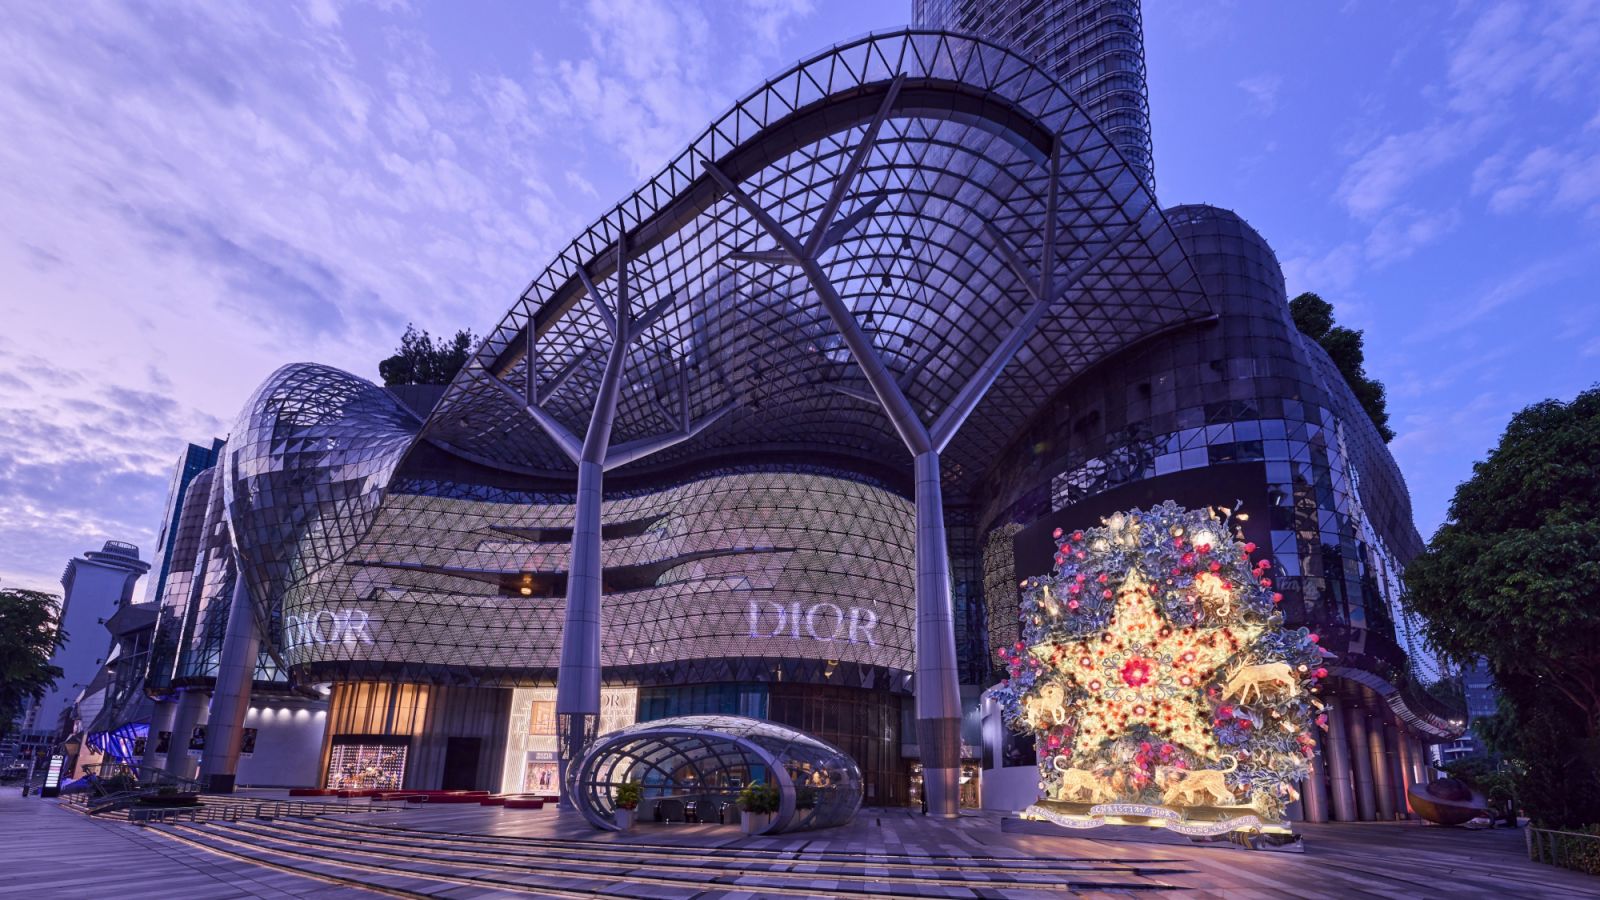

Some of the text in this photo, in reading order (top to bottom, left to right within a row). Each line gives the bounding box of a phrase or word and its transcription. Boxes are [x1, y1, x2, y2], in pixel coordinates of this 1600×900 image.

[284, 610, 375, 649] DIOR
[747, 600, 878, 647] DIOR
[1095, 805, 1172, 817] CHRISTIAN DIOR
